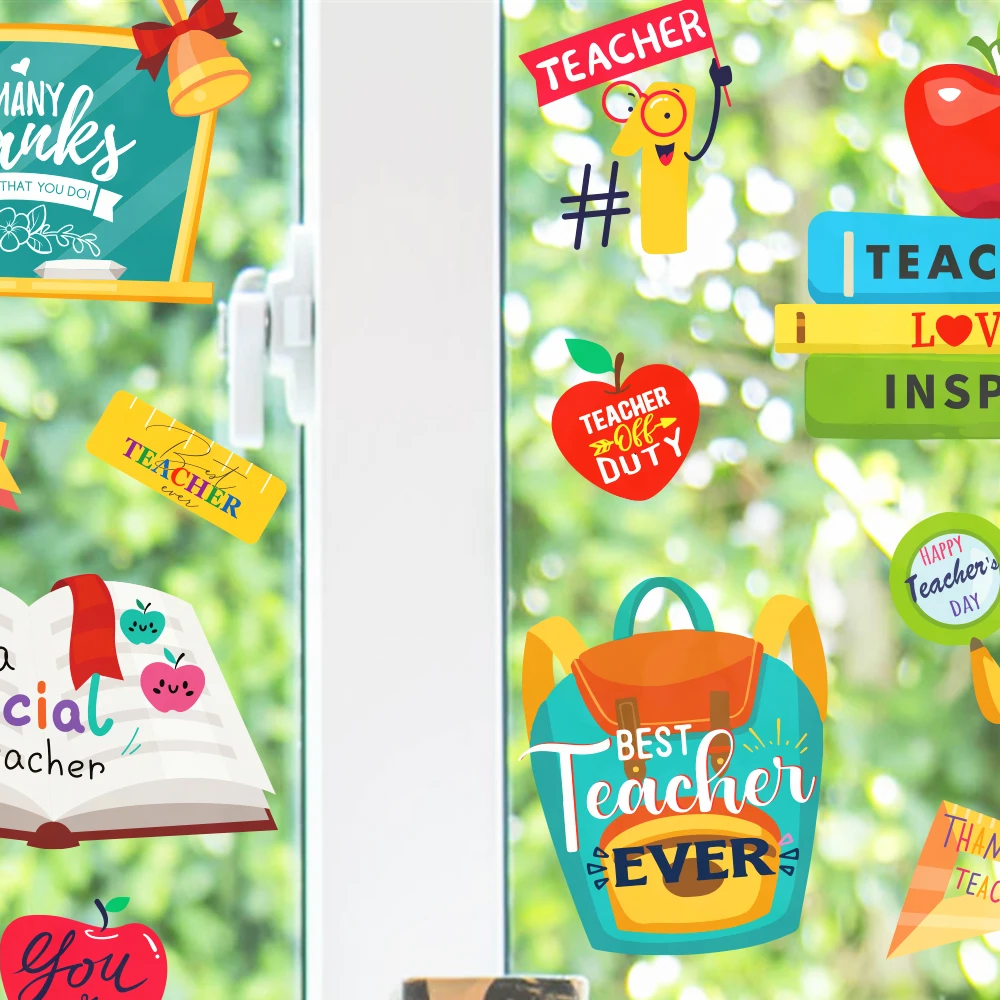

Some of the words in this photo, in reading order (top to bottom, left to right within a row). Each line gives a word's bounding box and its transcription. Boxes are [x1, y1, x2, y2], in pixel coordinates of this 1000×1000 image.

[536, 9, 706, 91] TEACHER
[0, 180, 33, 192] THAT
[37, 181, 65, 196] YOU
[67, 185, 91, 200] DO!
[865, 243, 996, 280] TEAC
[579, 386, 671, 435] TEACHER
[886, 373, 1000, 410] INSP
[613, 413, 655, 452] Off
[145, 424, 248, 490] Best
[595, 426, 682, 485] DUTY
[122, 436, 242, 519] TEACHER
[161, 485, 199, 508] ever
[919, 535, 963, 566] HAPPY
[904, 557, 1000, 603] Teacher's
[949, 592, 980, 618] DAY
[616, 723, 693, 761] BEST
[517, 728, 817, 853] Teacher
[611, 837, 777, 888] EVER
